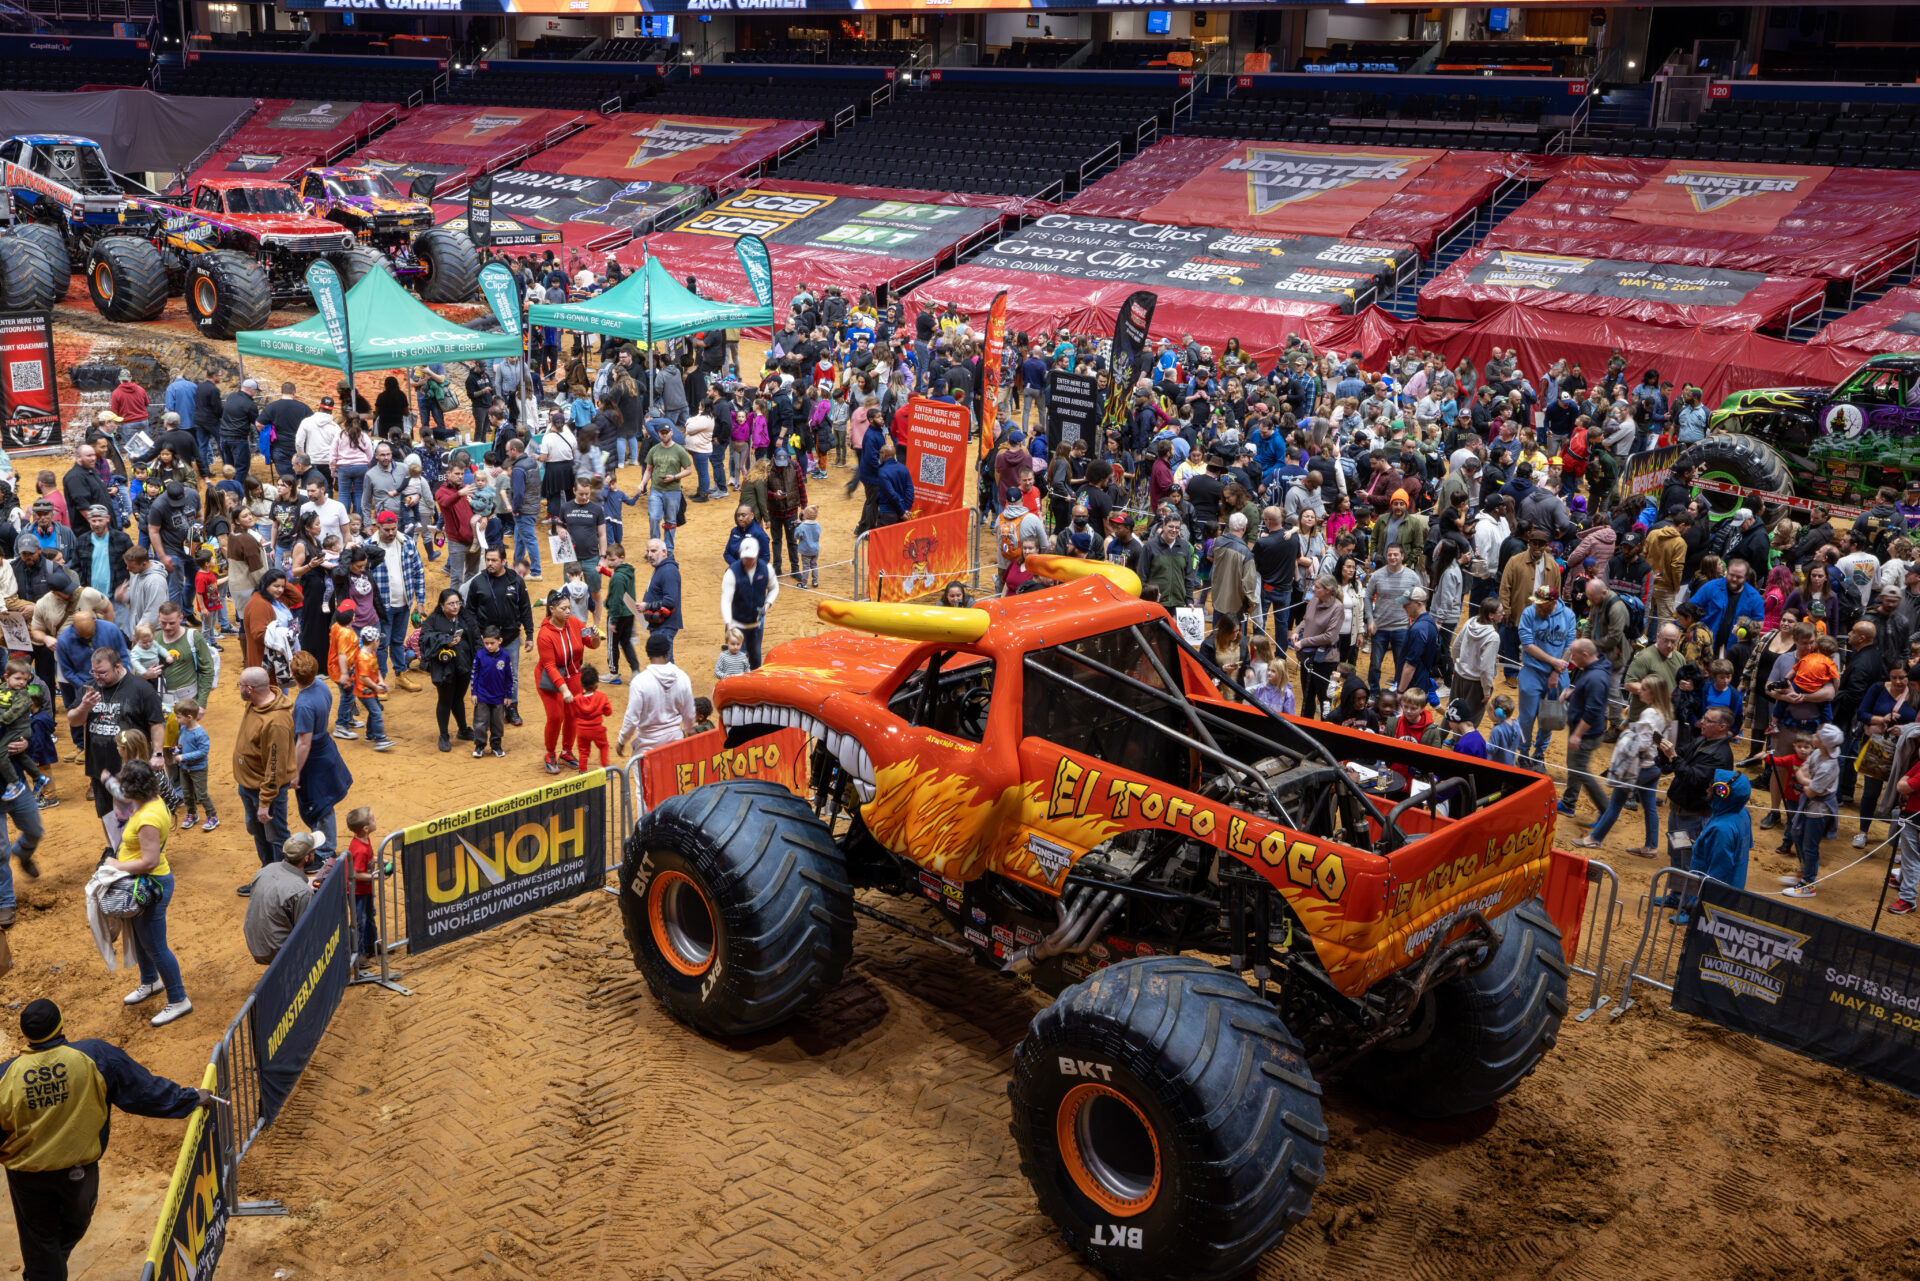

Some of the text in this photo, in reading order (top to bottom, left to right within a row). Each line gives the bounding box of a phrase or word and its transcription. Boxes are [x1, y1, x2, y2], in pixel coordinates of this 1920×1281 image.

[384, 0, 462, 11] GARNER
[1239, 78, 1250, 86] 121
[1571, 83, 1585, 94] 121
[1711, 85, 1727, 97] 120
[1220, 158, 1408, 180] MONSTER
[6, 163, 73, 205] RAMMUNITION
[1252, 175, 1342, 190] JAM
[1664, 174, 1800, 194] MONSTER
[474, 199, 490, 207] JCB
[731, 195, 820, 212] JCB
[867, 202, 960, 219] BKT
[472, 208, 490, 217] DIG
[689, 216, 779, 235] JCB
[1036, 214, 1208, 243] Great Clips
[496, 235, 536, 245] DIG ZONE
[543, 234, 559, 242] JCB
[825, 225, 918, 243] BKT
[1024, 231, 1051, 240] IT'S
[1052, 233, 1101, 246] GONNA
[1104, 239, 1123, 248] BE
[1220, 235, 1283, 247] SUPER
[1231, 229, 1302, 241] THE ORIGINAL
[1208, 242, 1254, 254] GLUE
[1338, 238, 1362, 247] THE
[993, 239, 1167, 271] Great Clips
[1315, 252, 1367, 264] GLUE
[1327, 245, 1395, 257] SUPER
[309, 266, 333, 275] Great
[981, 256, 1137, 280] IT'S GONNA BE GREAT
[1178, 262, 1242, 276] SUPER
[1189, 257, 1261, 269] THE ORIGINAL
[1298, 266, 1321, 275] THE
[1490, 258, 1585, 275] MONSTER
[312, 274, 332, 285] Clips
[481, 271, 509, 281] Great
[1166, 270, 1211, 282] GLUE
[1285, 273, 1355, 287] SUPER
[1489, 272, 1559, 285] WORLD FINALS
[1618, 277, 1650, 287] MAY
[1651, 280, 1668, 291] 18,
[1663, 276, 1730, 287] Stadium
[484, 280, 508, 291] Clips
[754, 279, 769, 305] FREE
[1274, 281, 1324, 294] GLUE
[33, 324, 46, 332] LINE
[553, 313, 623, 328] IT'S GONNA BE GREAT
[694, 315, 718, 327] GONNA
[719, 313, 728, 322] BE
[328, 319, 348, 354] FREE
[369, 331, 480, 347] Great Clips
[261, 340, 325, 355] IT'S GONNA BE GREAT
[392, 343, 486, 359] IT'S GONNA BE GREAT
[1056, 377, 1070, 385] ENTER
[1056, 384, 1080, 394] AUTOGRAPH
[1070, 398, 1094, 408] ANDERSON
[914, 404, 960, 420] ENTER HERE FOR
[1056, 407, 1086, 419] GRAVE DIGGER
[913, 413, 961, 428] AUTOGRAPH LINE
[910, 425, 962, 442] ARMANDO CASTRO
[914, 438, 954, 453] EL TORO LOCO
[712, 743, 781, 781] Toro
[426, 779, 587, 835] Official Educational Partner
[425, 806, 585, 904] UNOH
[1027, 841, 1071, 868] MONSTER
[1038, 856, 1061, 873] JAM
[631, 851, 656, 898] BKT
[427, 859, 584, 920] UNIVERSITY OF NORTHWESTERN OHIO
[428, 871, 586, 937] UNOH.EDU/MONSTERJAM
[1107, 936, 1134, 952] MSD
[1697, 916, 1804, 965] MONSTER
[1721, 943, 1771, 971] JAM
[701, 960, 722, 1002] BKT
[1704, 957, 1781, 993] WORLD FINALS
[1825, 967, 1861, 991] SoFi
[268, 923, 340, 1061] MONSTERJAM.COM
[1829, 990, 1864, 1011] MAY
[1869, 1003, 1889, 1021] 18,
[24, 1062, 67, 1085] CSC
[1058, 1056, 1114, 1082] BKT
[26, 1079, 68, 1099] EVENT
[28, 1092, 70, 1110] STAFF
[1090, 1224, 1143, 1250] BKT
